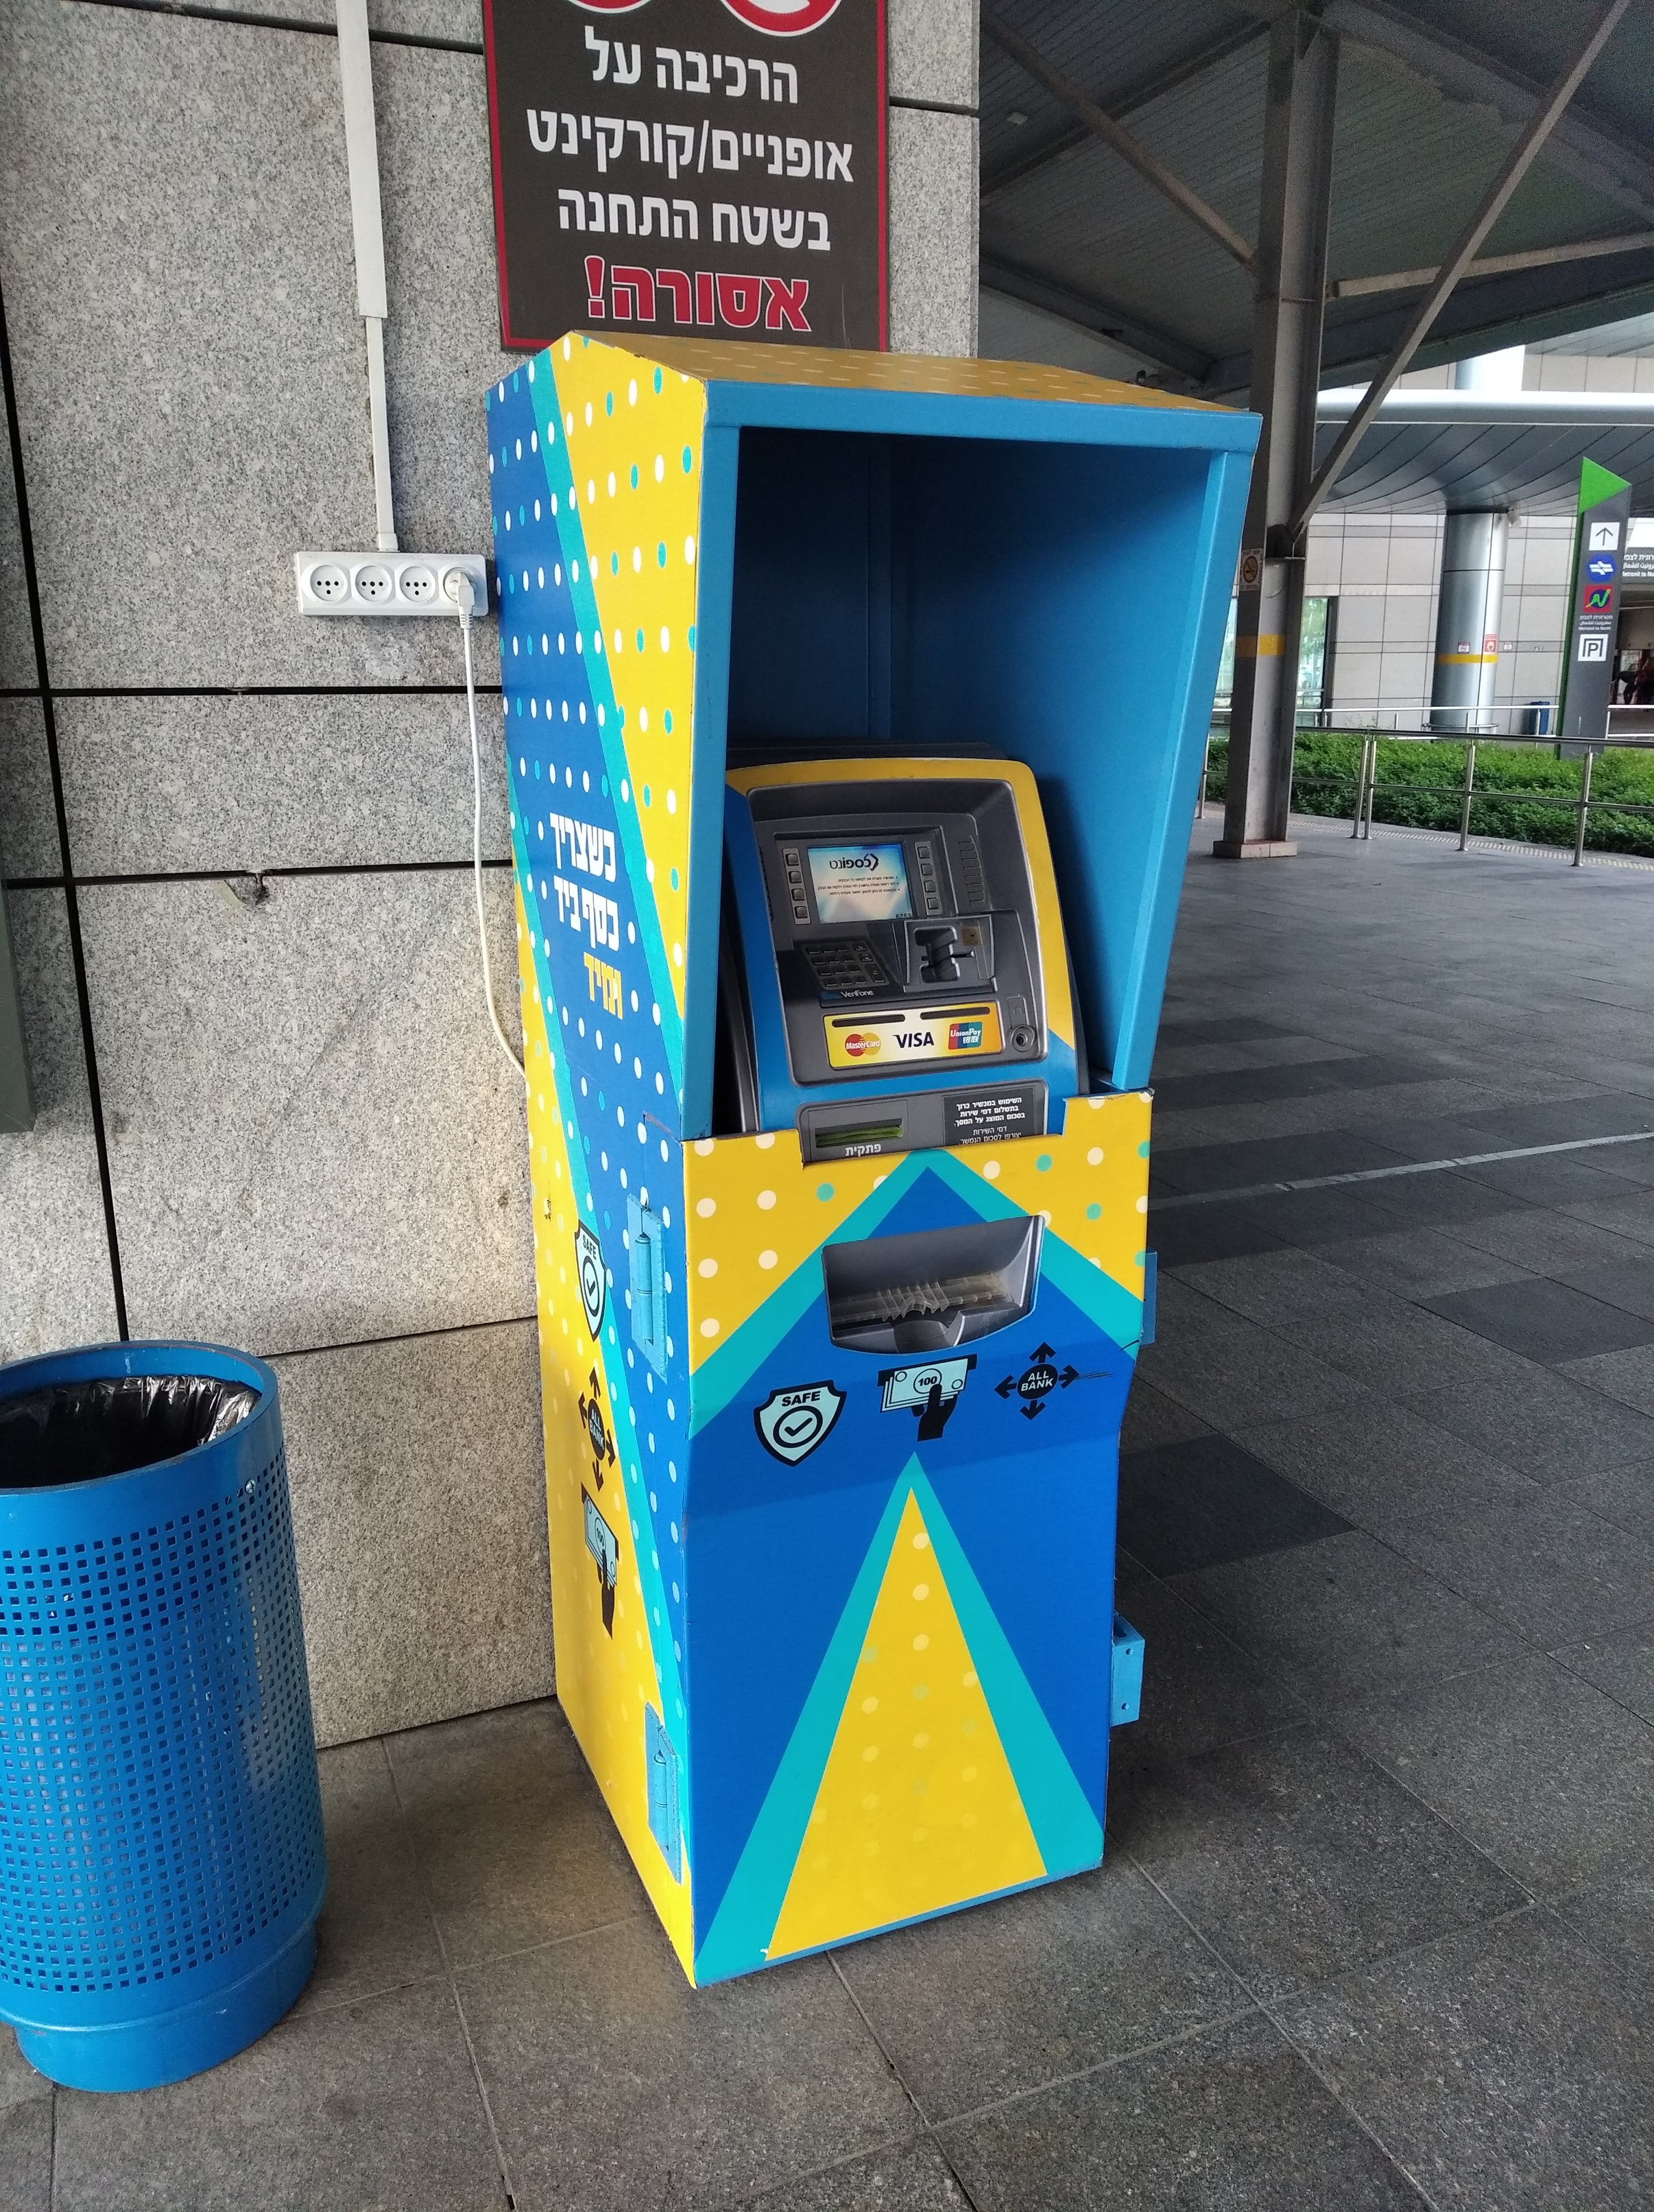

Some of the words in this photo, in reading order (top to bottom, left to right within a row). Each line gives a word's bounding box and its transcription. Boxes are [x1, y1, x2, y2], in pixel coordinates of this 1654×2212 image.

[584, 25, 642, 85] על
[656, 47, 798, 104] הרכיבה
[527, 108, 854, 182] אופניים/קורקינט
[558, 189, 699, 240] התחנה
[712, 203, 831, 251] בשטח
[584, 255, 813, 332] אסורה!
[1588, 643, 1598, 657] P
[549, 812, 616, 883] כשצריך
[553, 875, 582, 932] ביד
[582, 888, 620, 952] כסף
[892, 1032, 935, 1049] VISA
[950, 1028, 981, 1038] UnionPay
[846, 1040, 880, 1050] MasterCard
[956, 1103, 970, 1111] כרוך
[973, 1127, 994, 1136] השירות
[983, 1133, 1002, 1142] לסכום
[845, 1143, 881, 1157] פתקית
[582, 1234, 597, 1261] SAFE
[918, 1376, 937, 1386] 100
[1021, 1377, 1053, 1392] BANK
[1027, 1370, 1049, 1381] ALL
[781, 1390, 821, 1408] SAFE
[591, 1408, 601, 1432] ALL
[590, 1418, 604, 1451] BANK
